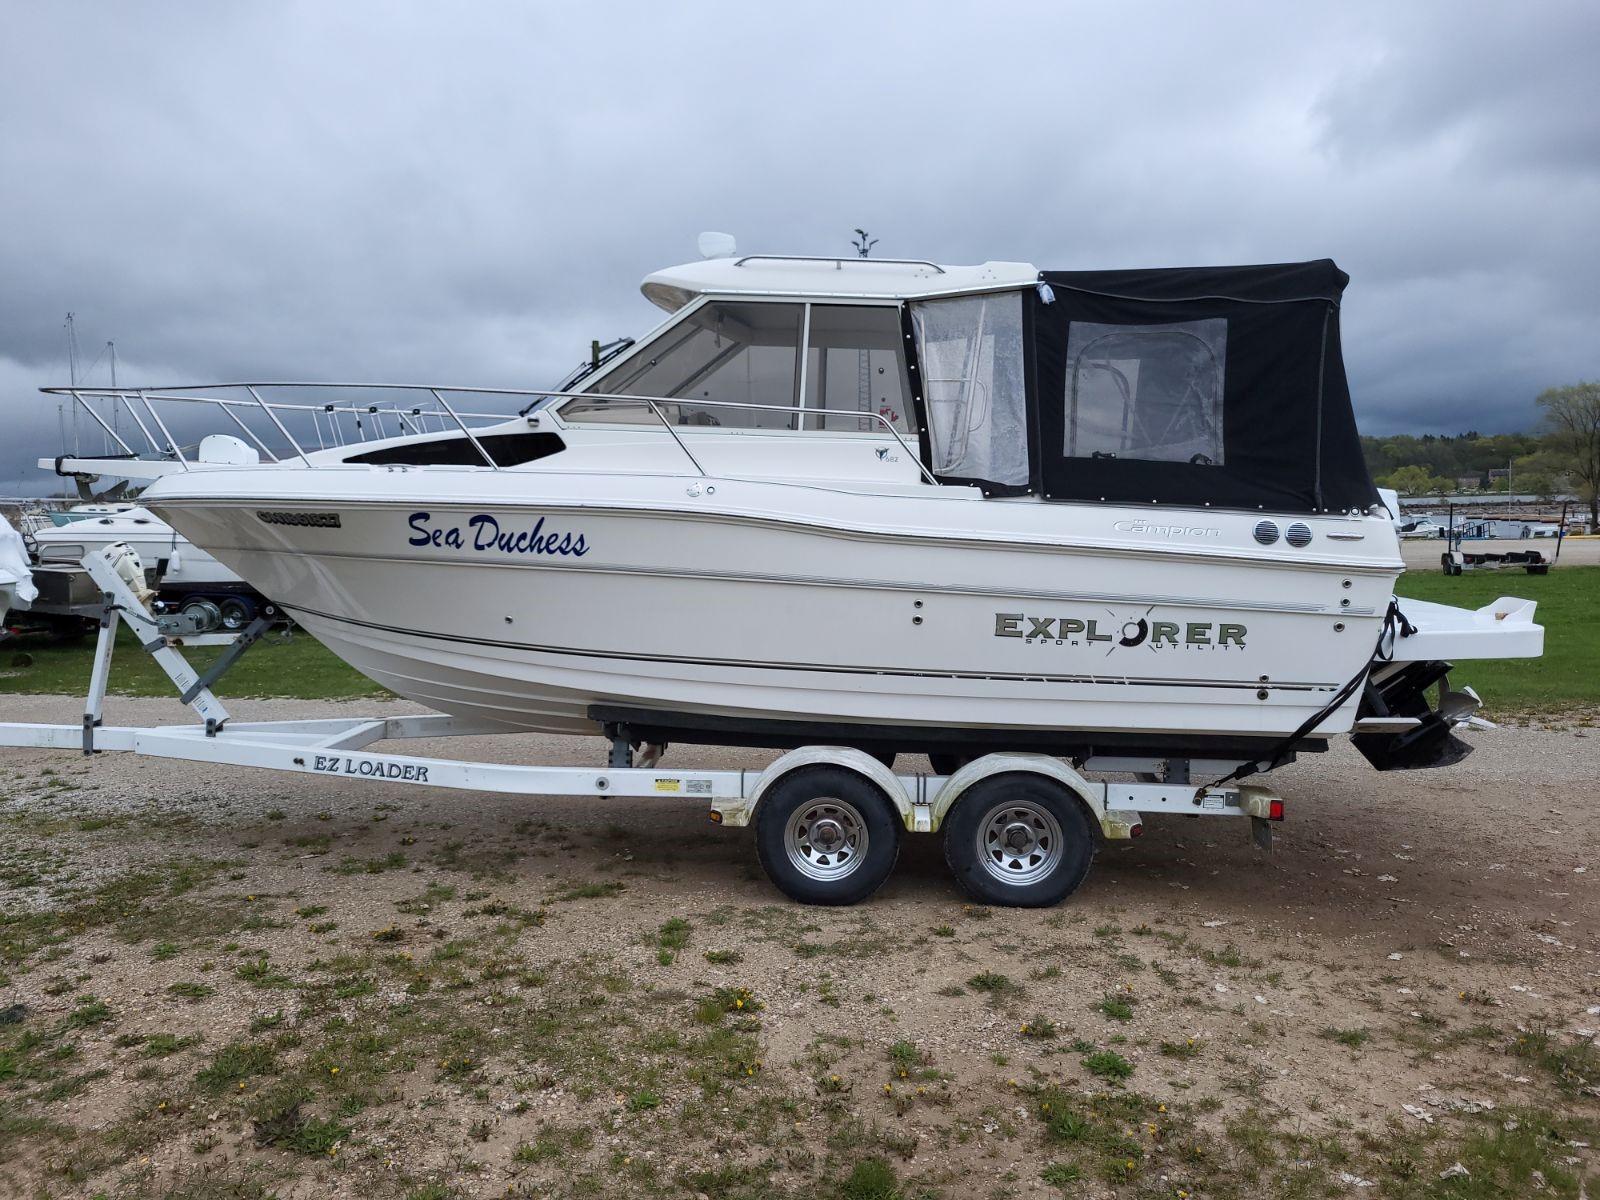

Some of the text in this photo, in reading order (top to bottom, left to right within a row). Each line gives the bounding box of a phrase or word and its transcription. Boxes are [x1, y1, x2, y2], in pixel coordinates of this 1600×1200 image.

[408, 512, 591, 557] Sea Duchess
[994, 611, 1248, 648] EXPLORER
[1024, 638, 1246, 652] SPORT UTILITY
[314, 756, 429, 782] EZ LOADER
